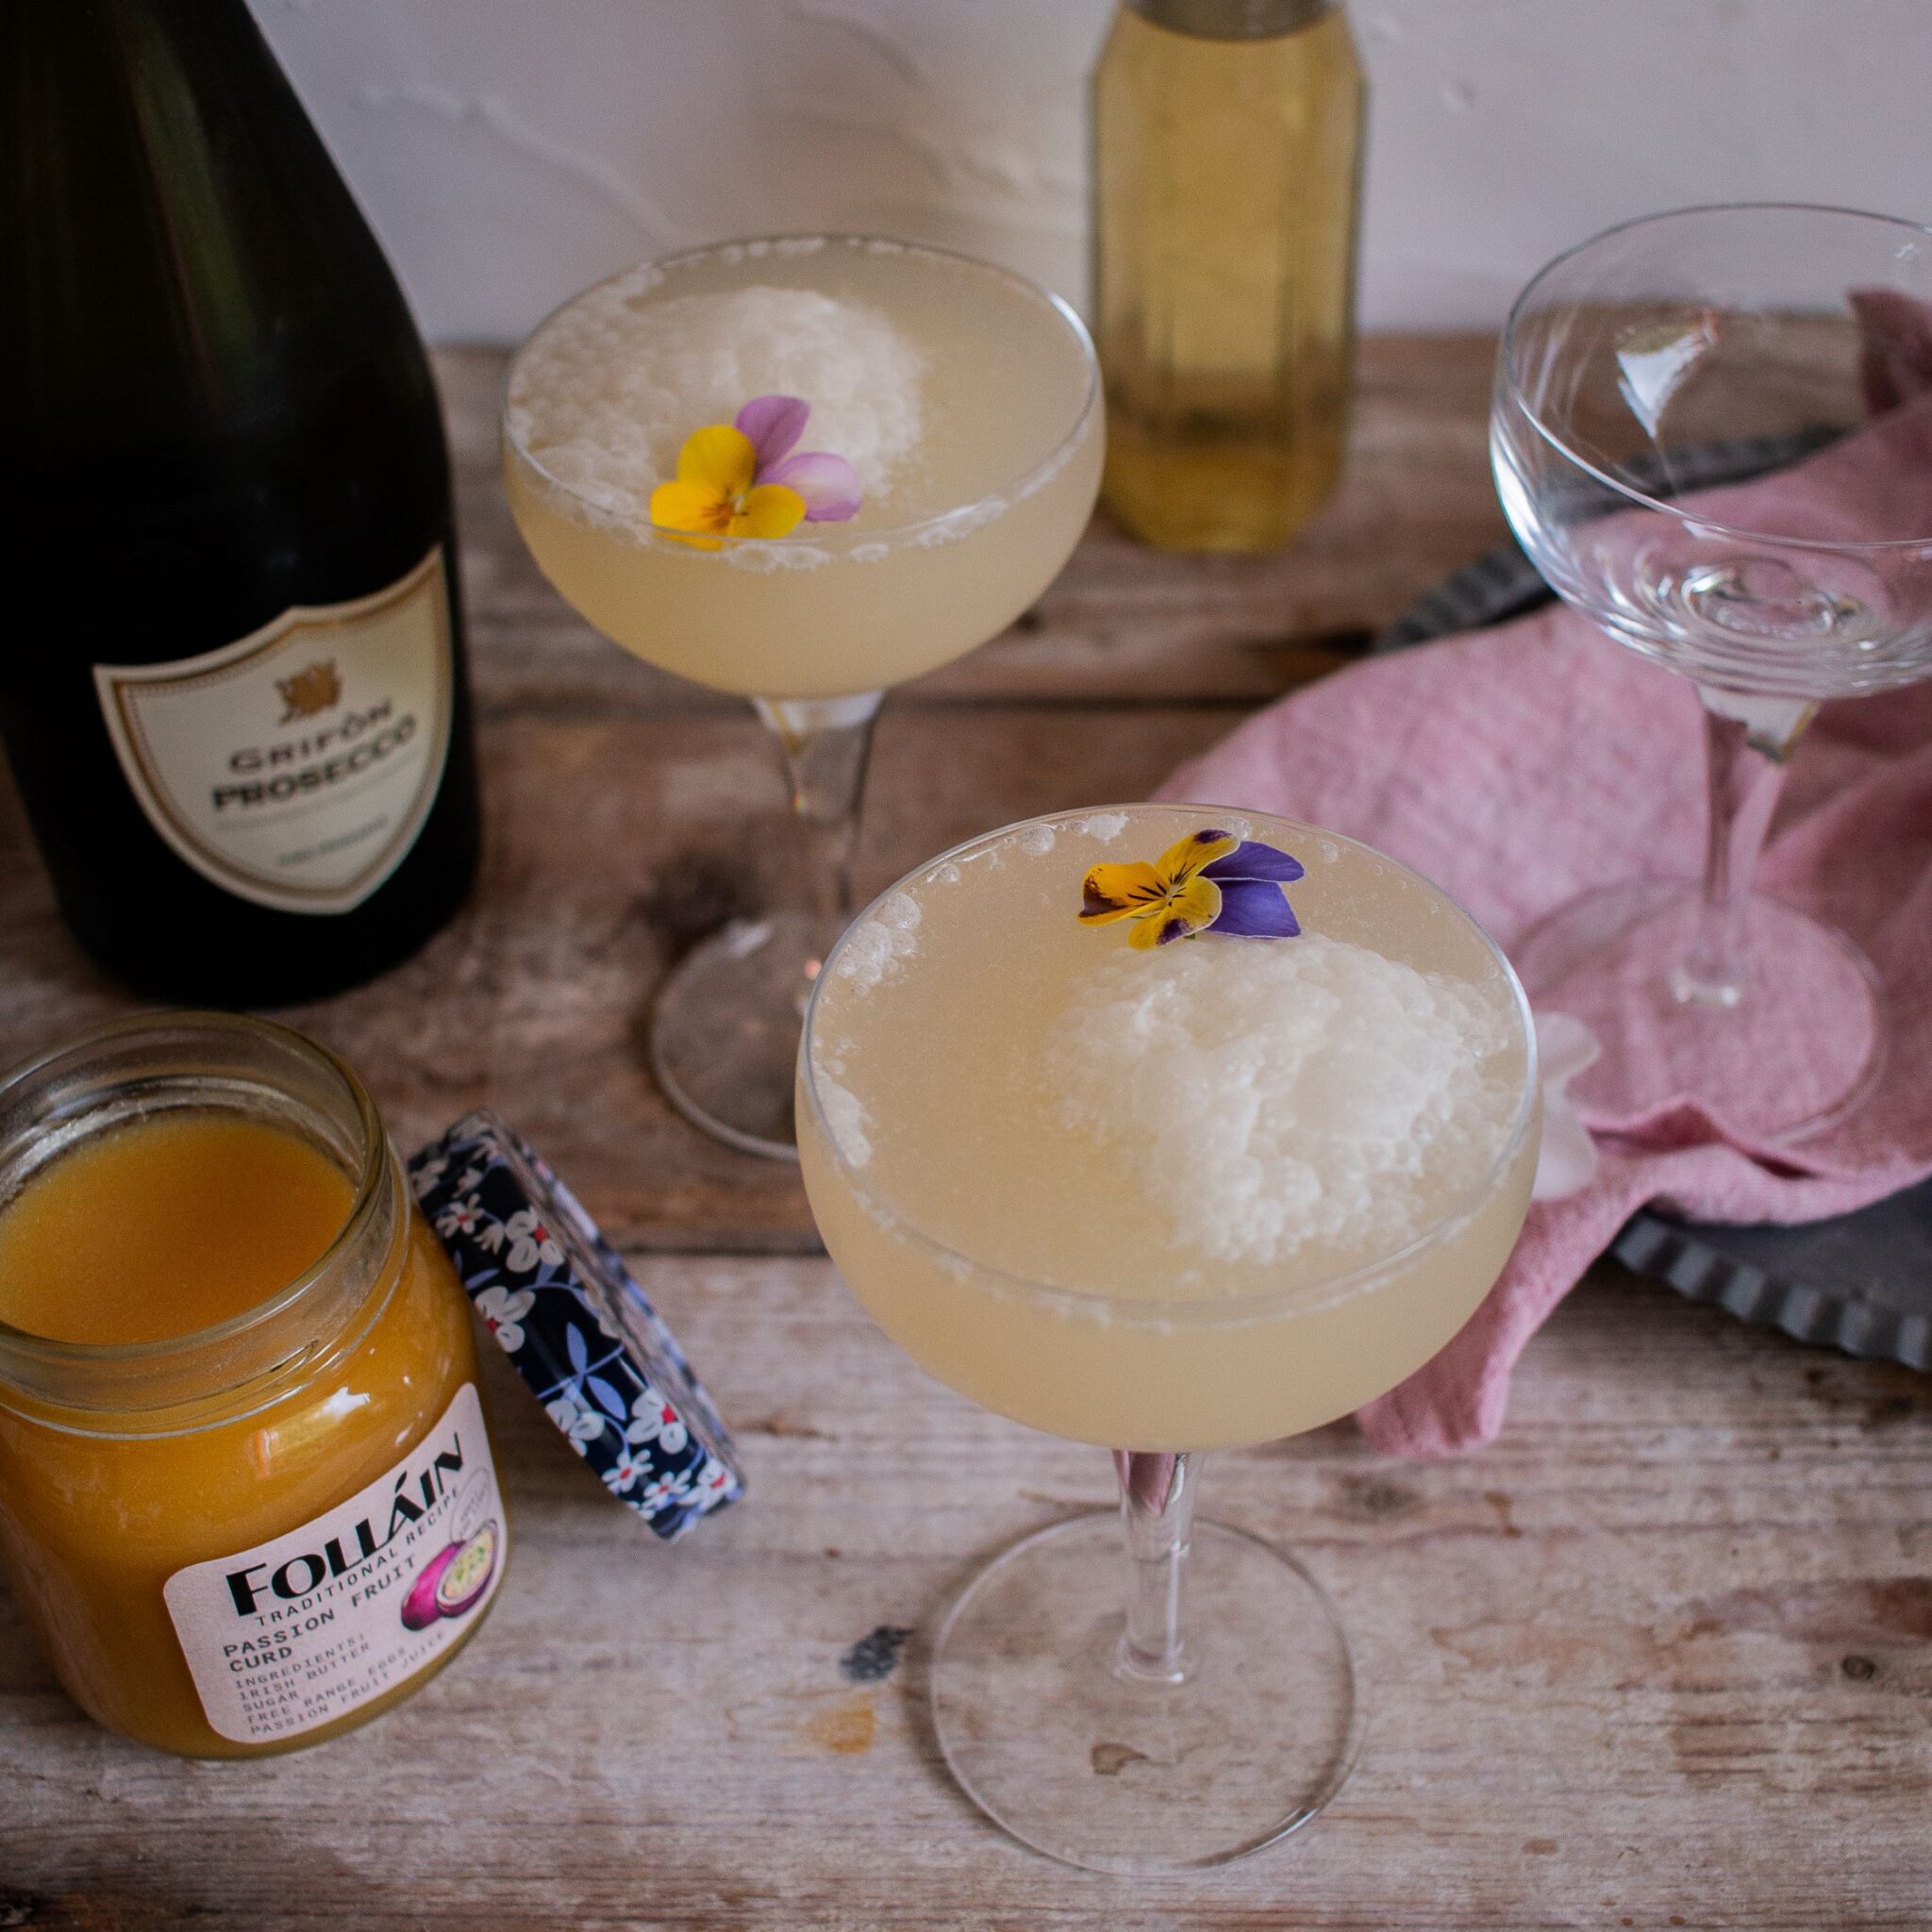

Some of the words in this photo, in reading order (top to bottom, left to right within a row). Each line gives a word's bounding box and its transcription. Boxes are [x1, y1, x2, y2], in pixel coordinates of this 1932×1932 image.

[213, 714, 417, 811] PROSECCO
[226, 1432, 465, 1616] FOLLÁIN
[224, 1607, 335, 1657] PASSION
[352, 1553, 417, 1607] FRUIT
[256, 1548, 398, 1626] TRADITIONAL
[229, 1646, 293, 1673] CURD
[235, 1633, 365, 1690] INGREDIENTS:
[240, 1679, 295, 1701] IRISH
[308, 1642, 370, 1681] BUTTER
[246, 1707, 292, 1724] FREE
[304, 1679, 357, 1707] RANGE
[368, 1646, 408, 1674] EGGS
[250, 1704, 329, 1735] PASSION
[341, 1673, 391, 1705] FRUIT
[402, 1631, 445, 1669] JUICE
[242, 1690, 300, 1712] SUGAR
